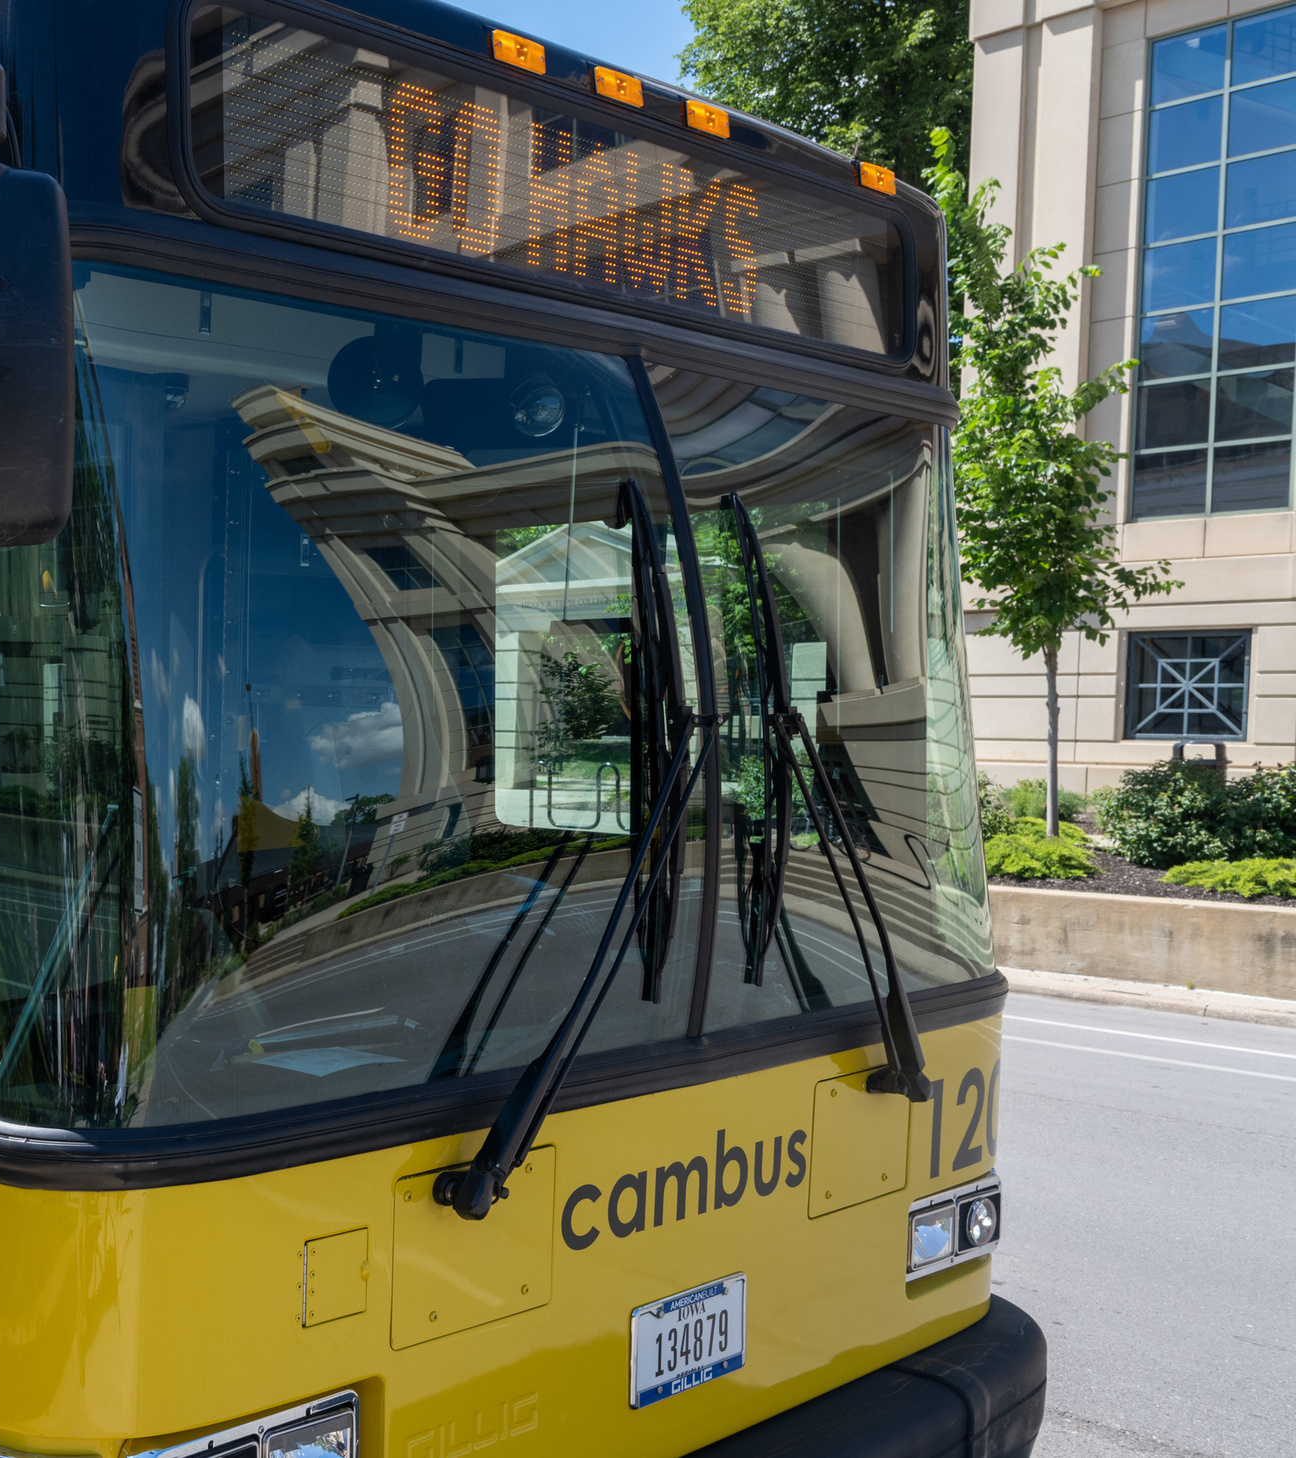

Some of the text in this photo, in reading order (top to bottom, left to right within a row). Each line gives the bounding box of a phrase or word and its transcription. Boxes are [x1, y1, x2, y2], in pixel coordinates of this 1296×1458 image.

[388, 82, 759, 315] GO HAWKS
[561, 1128, 808, 1252] cambus
[655, 1309, 729, 1378] 134879
[677, 1300, 706, 1323] IOWA
[671, 1366, 713, 1396] GILLIG
[404, 1390, 539, 1458] GILLIG
